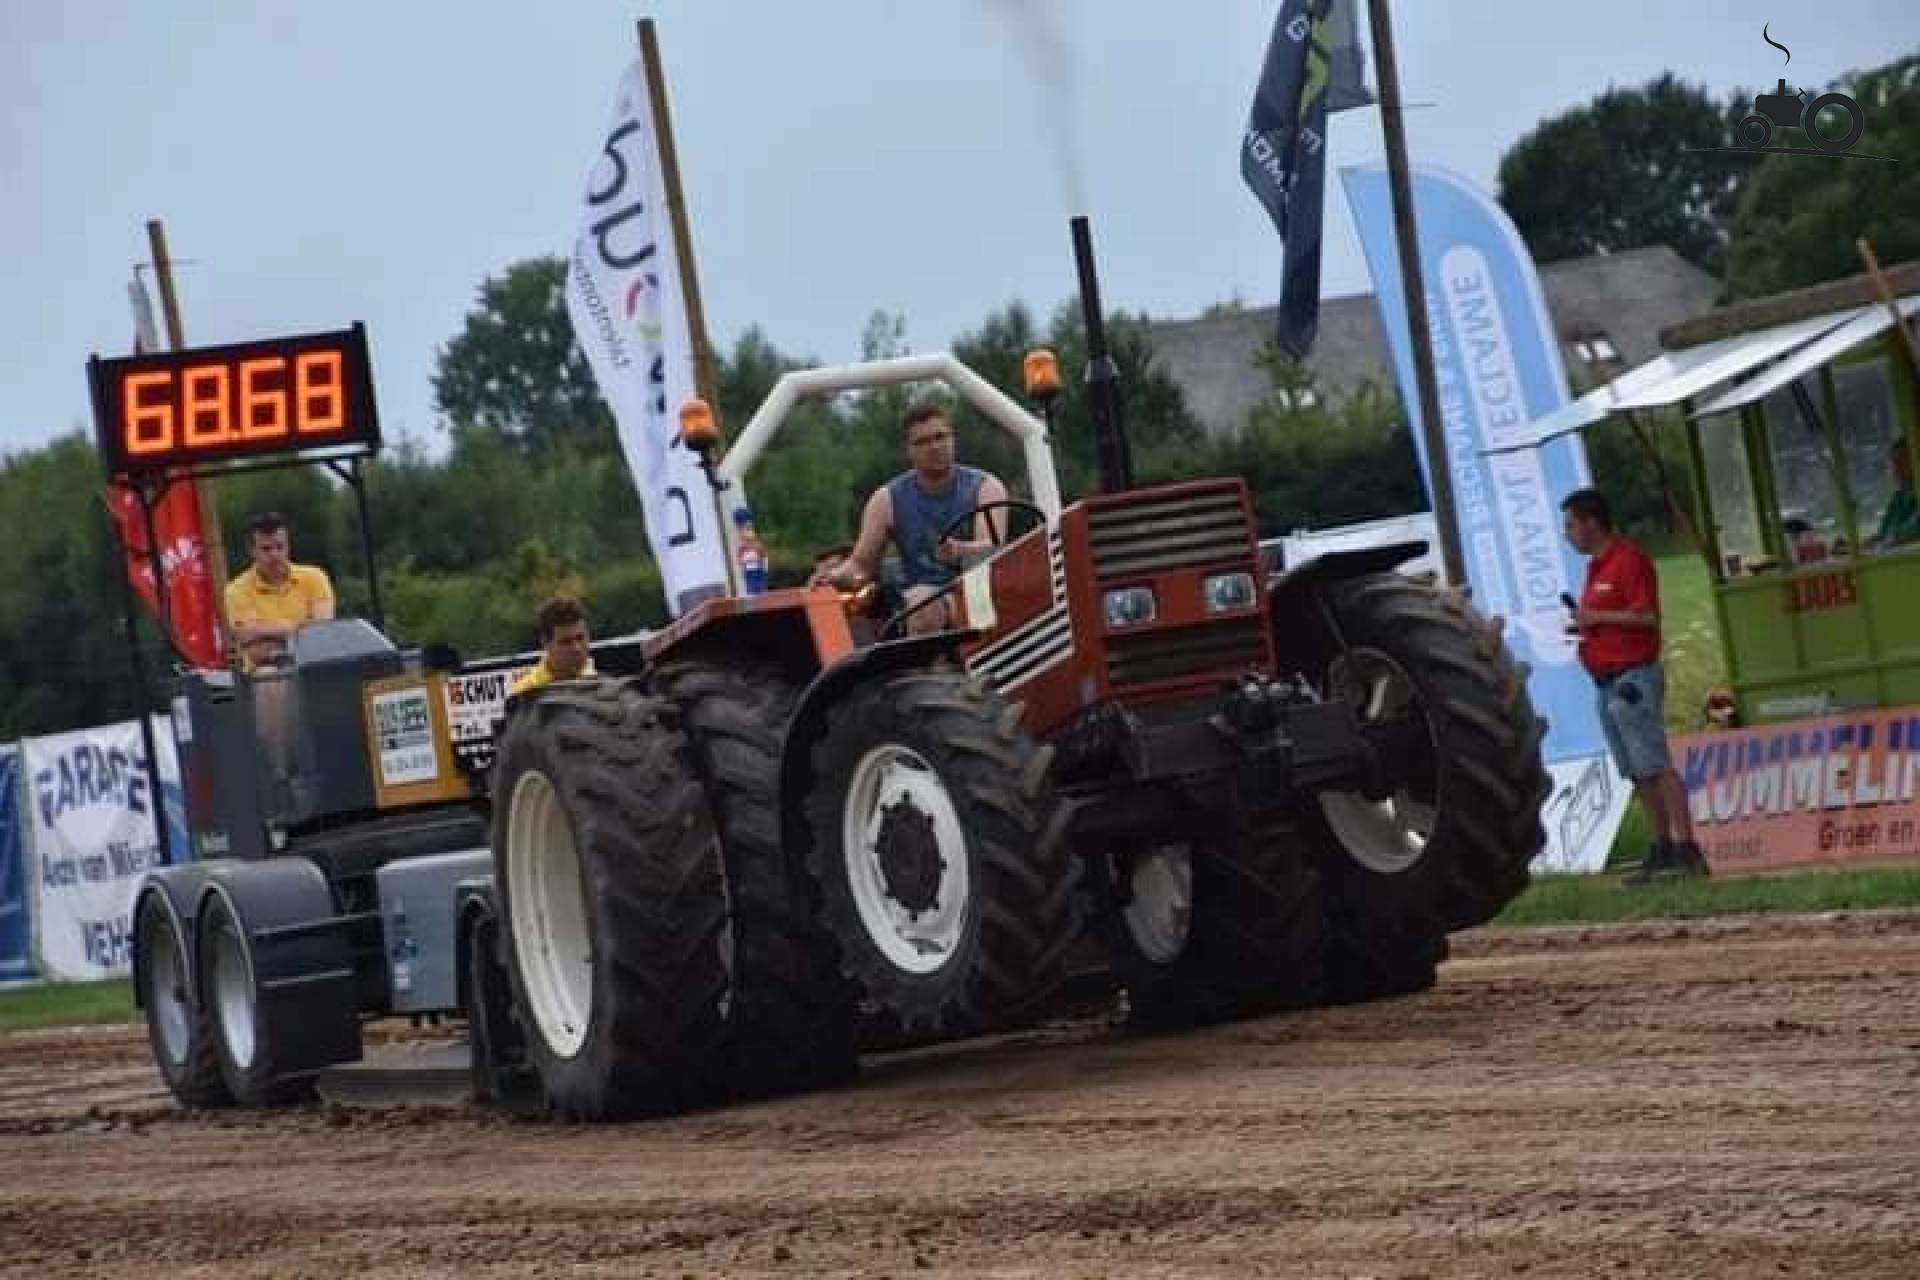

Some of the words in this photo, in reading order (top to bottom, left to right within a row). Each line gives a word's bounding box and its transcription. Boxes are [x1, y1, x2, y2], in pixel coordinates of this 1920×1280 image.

[125, 351, 344, 454] 68.68
[1818, 818, 1881, 852] Groen
[1887, 819, 1914, 843] en
